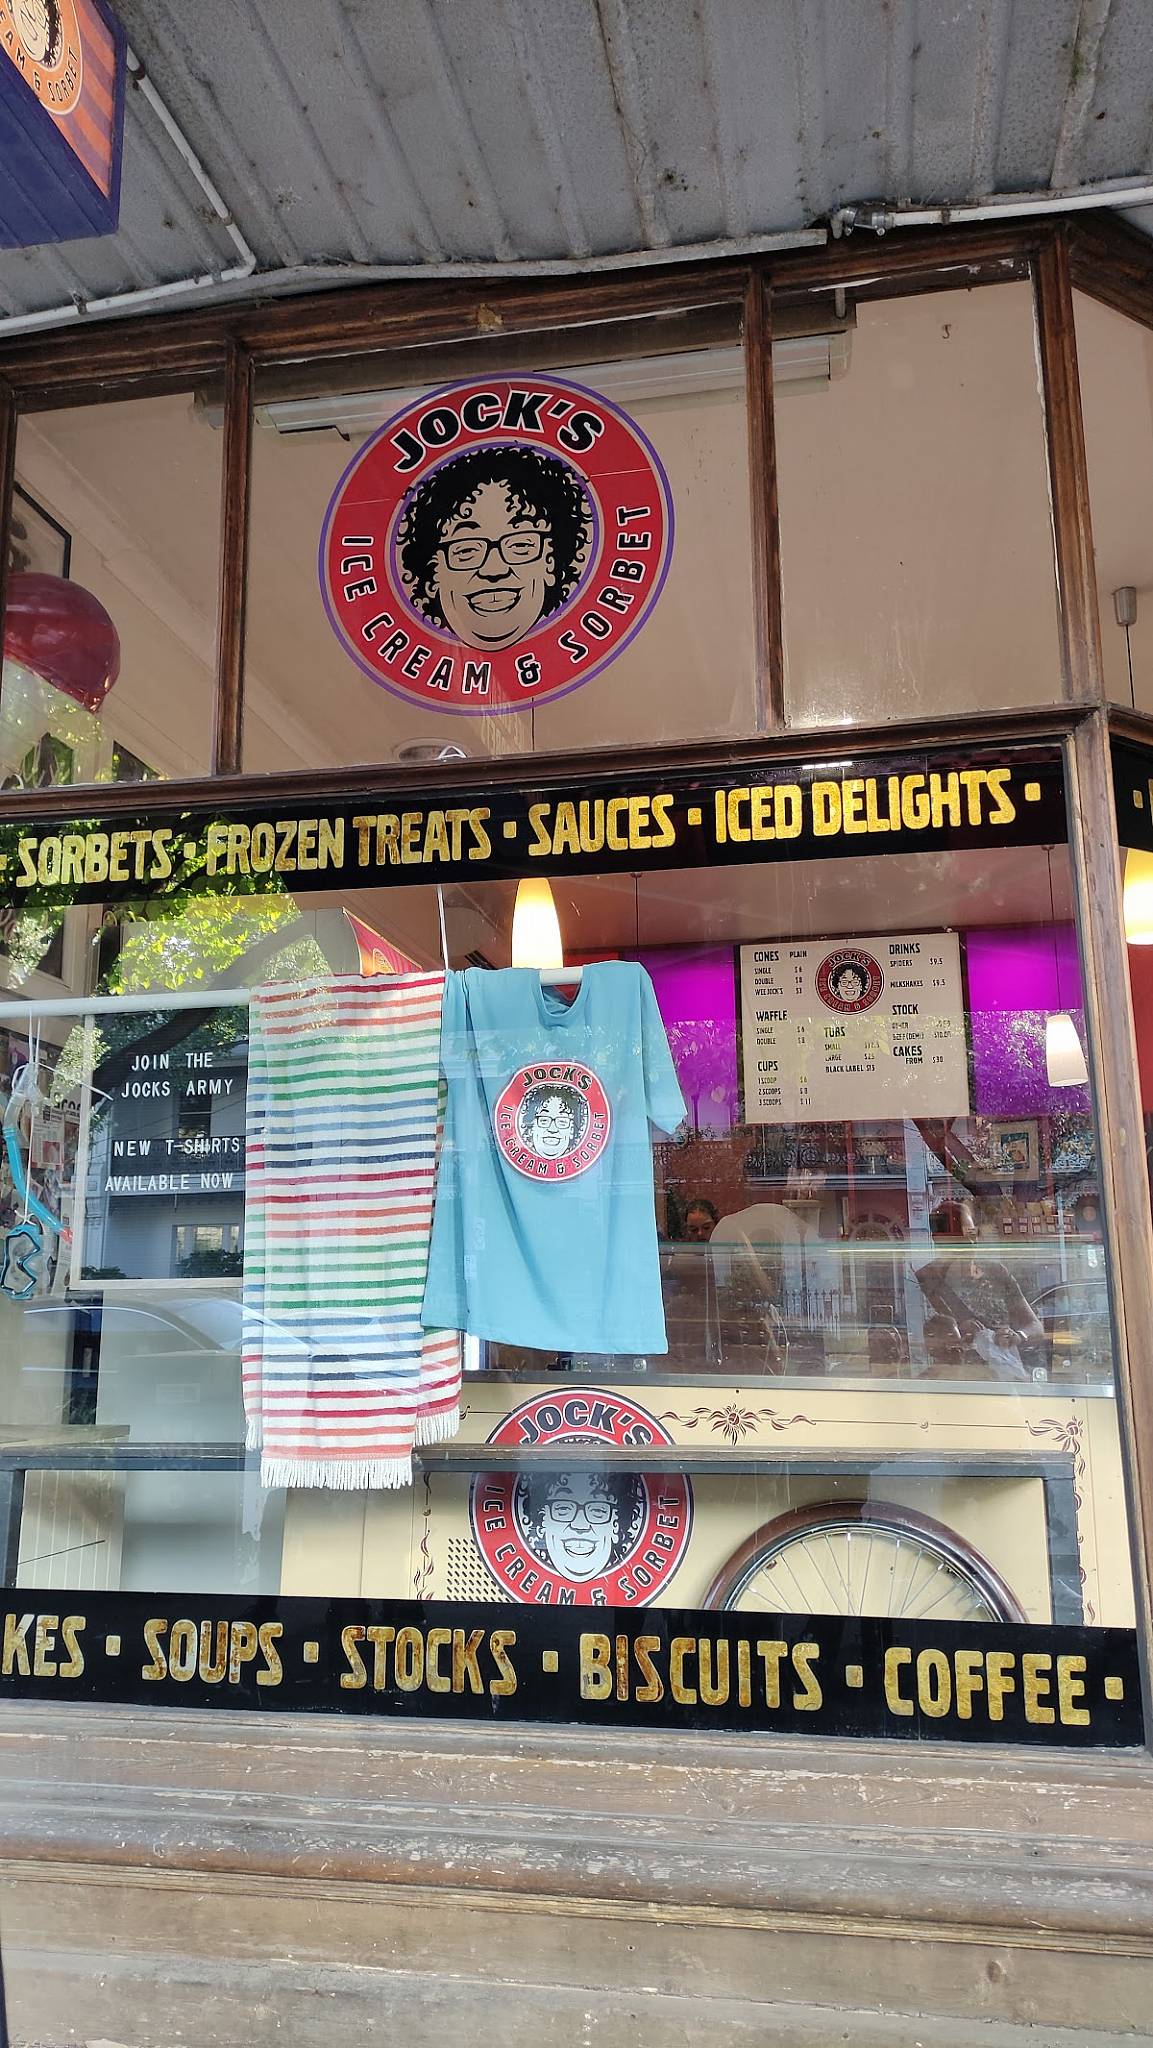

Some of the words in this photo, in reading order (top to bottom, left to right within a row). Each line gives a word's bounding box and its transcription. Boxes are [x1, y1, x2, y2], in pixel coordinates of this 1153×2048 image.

[47, 46, 78, 102] SORBET
[390, 389, 605, 473] JOCK'S
[340, 536, 377, 602] ICE
[362, 612, 491, 694] CREAM
[515, 653, 541, 686] &
[558, 505, 651, 663] SORBET
[16, 828, 173, 888] SORBETS
[206, 817, 345, 876] FROZEN
[353, 807, 491, 866] TREATS
[528, 794, 676, 856] SAUCES
[715, 784, 802, 843] ICED
[812, 768, 1016, 836] DELIGHTS
[754, 950, 780, 962] CONES
[889, 943, 920, 955] DRINKS
[756, 1010, 788, 1021] WAFFLE
[892, 1004, 919, 1015] STOCK
[824, 1026, 846, 1038] TUBS
[893, 1045, 923, 1057] CAKES
[132, 1053, 169, 1071] JOIN
[185, 1052, 213, 1068] THE
[757, 1060, 778, 1071] CUPS
[825, 1065, 845, 1073] BLACK
[845, 1064, 864, 1072] LABEL
[905, 1057, 924, 1065] FROM
[523, 1067, 593, 1090] JOCK'S
[121, 1081, 170, 1098] JOCKS
[186, 1079, 233, 1096] ARMY
[501, 1104, 514, 1129] ICE
[114, 1140, 151, 1156] NEW
[166, 1137, 240, 1155] T-SHIRTS
[572, 1112, 605, 1168] SORBET
[505, 1137, 548, 1174] CREAM
[557, 1163, 565, 1174] &
[105, 1174, 190, 1191] AVAILABLE
[201, 1173, 233, 1188] NOW
[483, 1485, 506, 1532] ICE
[496, 1543, 576, 1605] CREAM
[619, 1495, 681, 1600] SORBET
[1, 1613, 87, 1678] KES
[141, 1618, 285, 1686] SOUPS
[339, 1625, 519, 1697] STOCKS
[579, 1633, 823, 1711] BISCUITS
[885, 1647, 1092, 1727] COFFEE
